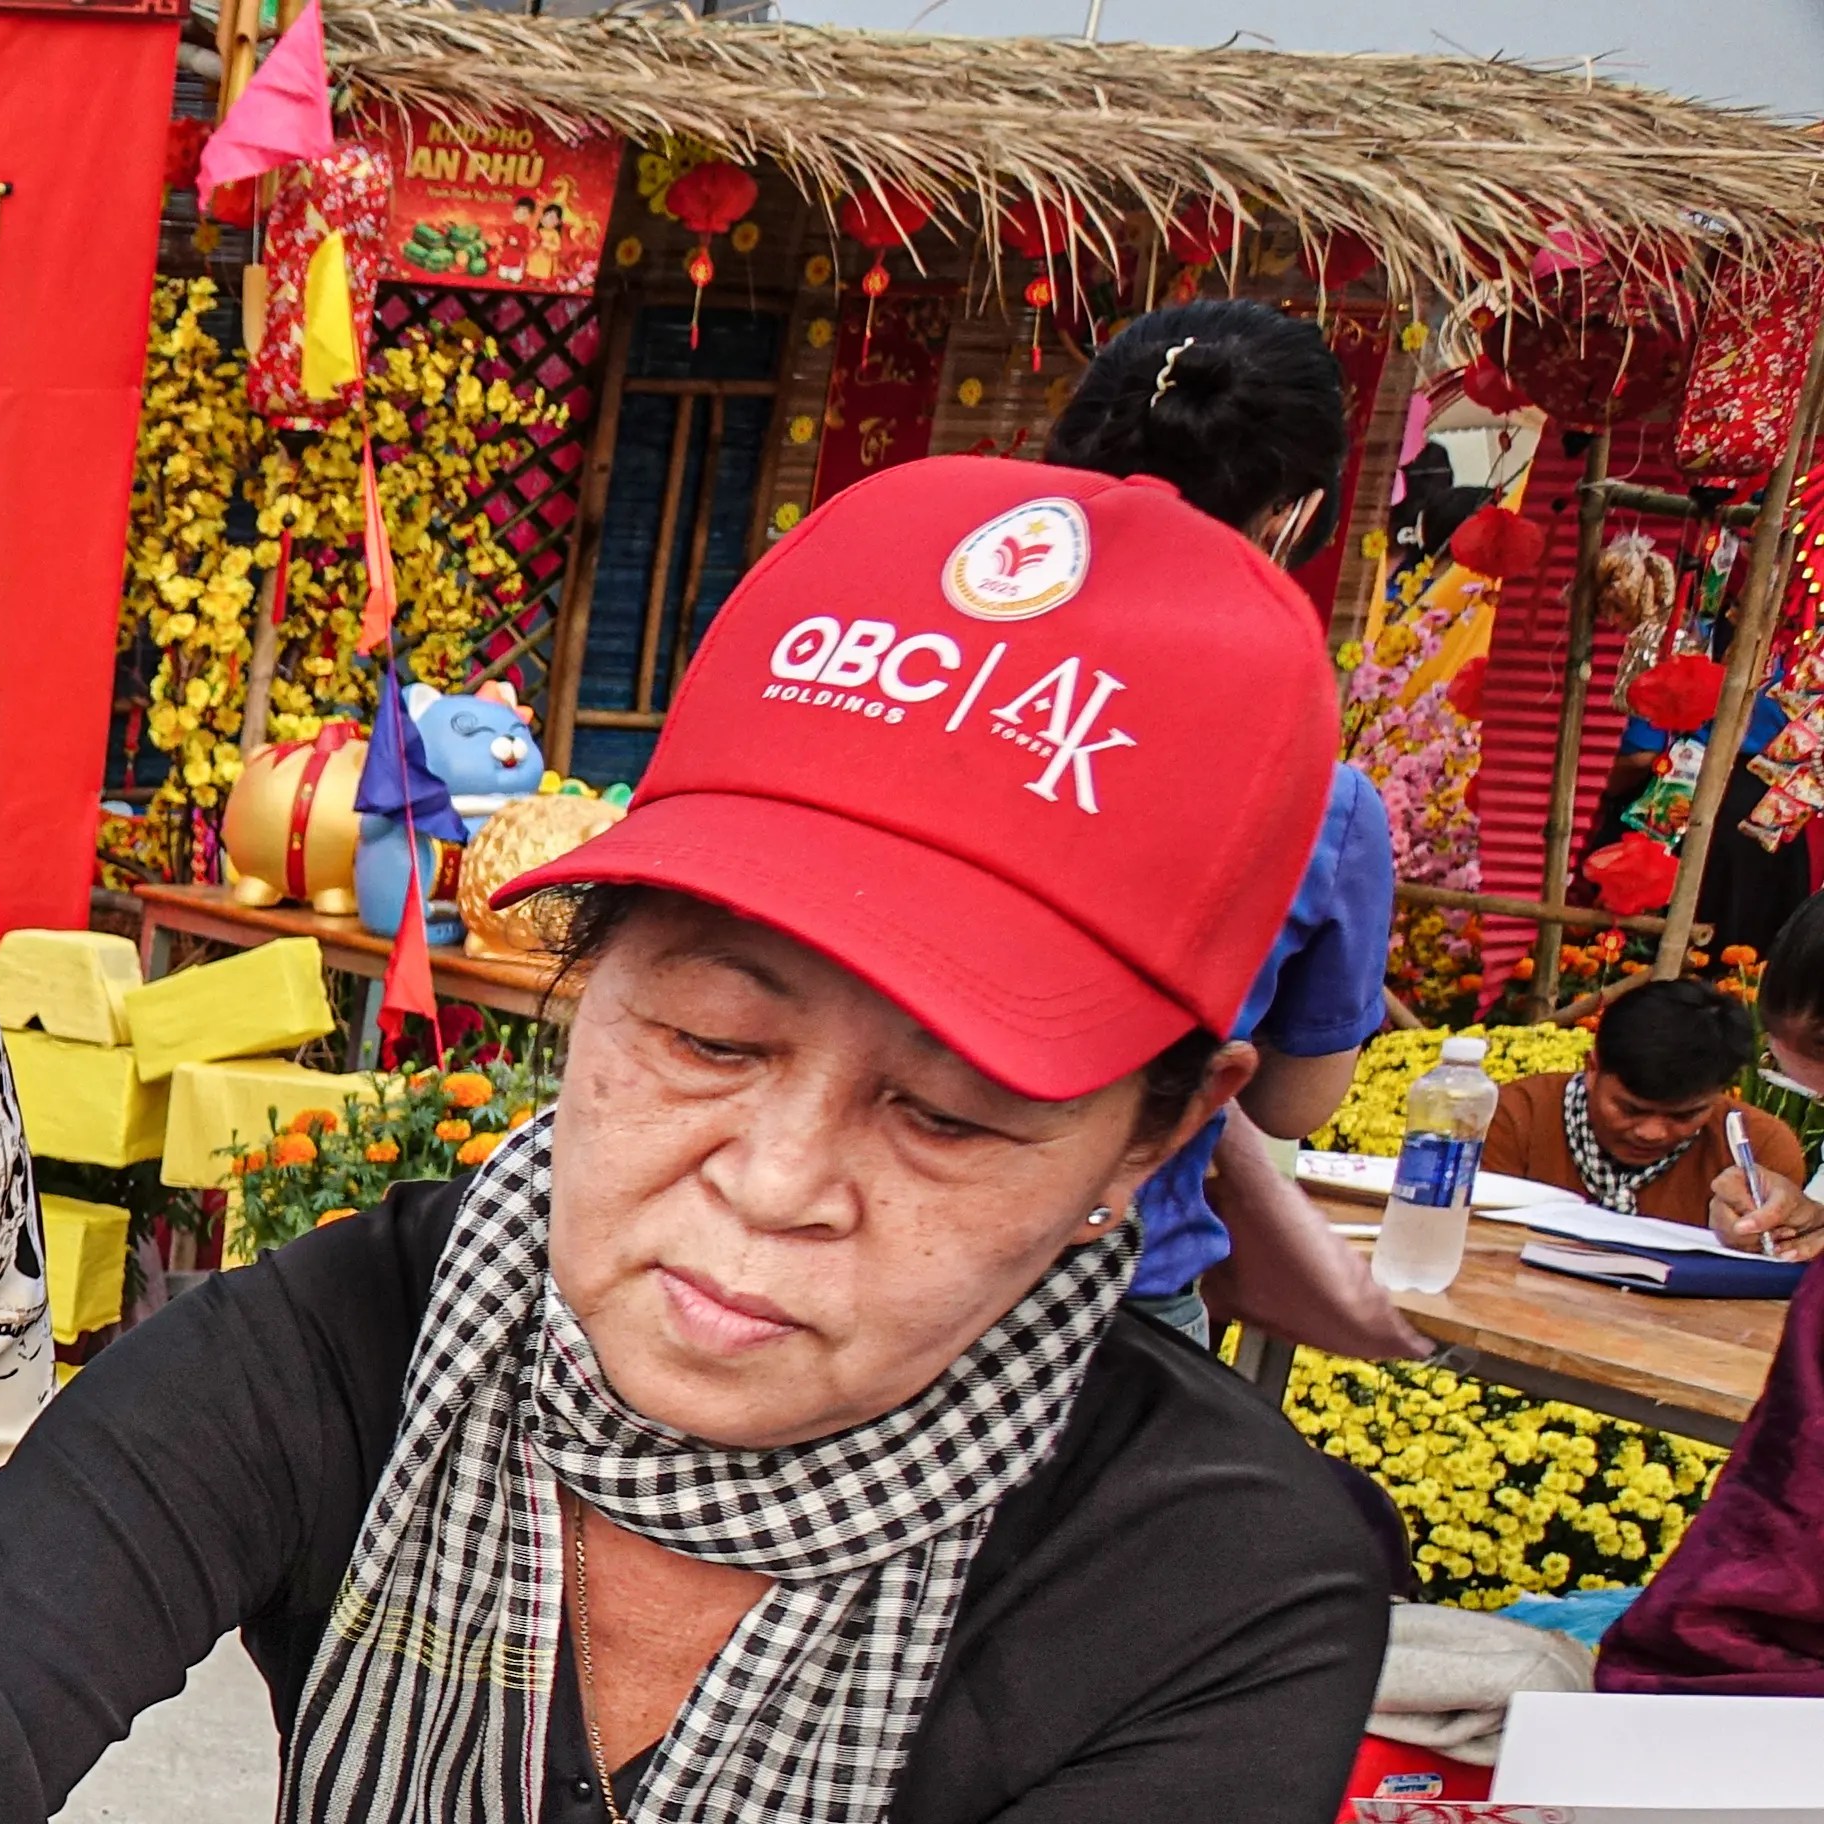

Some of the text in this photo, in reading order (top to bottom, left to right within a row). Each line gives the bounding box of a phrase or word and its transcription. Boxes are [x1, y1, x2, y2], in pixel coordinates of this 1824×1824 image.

[405, 146, 461, 183] AN
[761, 683, 907, 726] HOLDINGS
[990, 721, 1053, 759] TOWER
